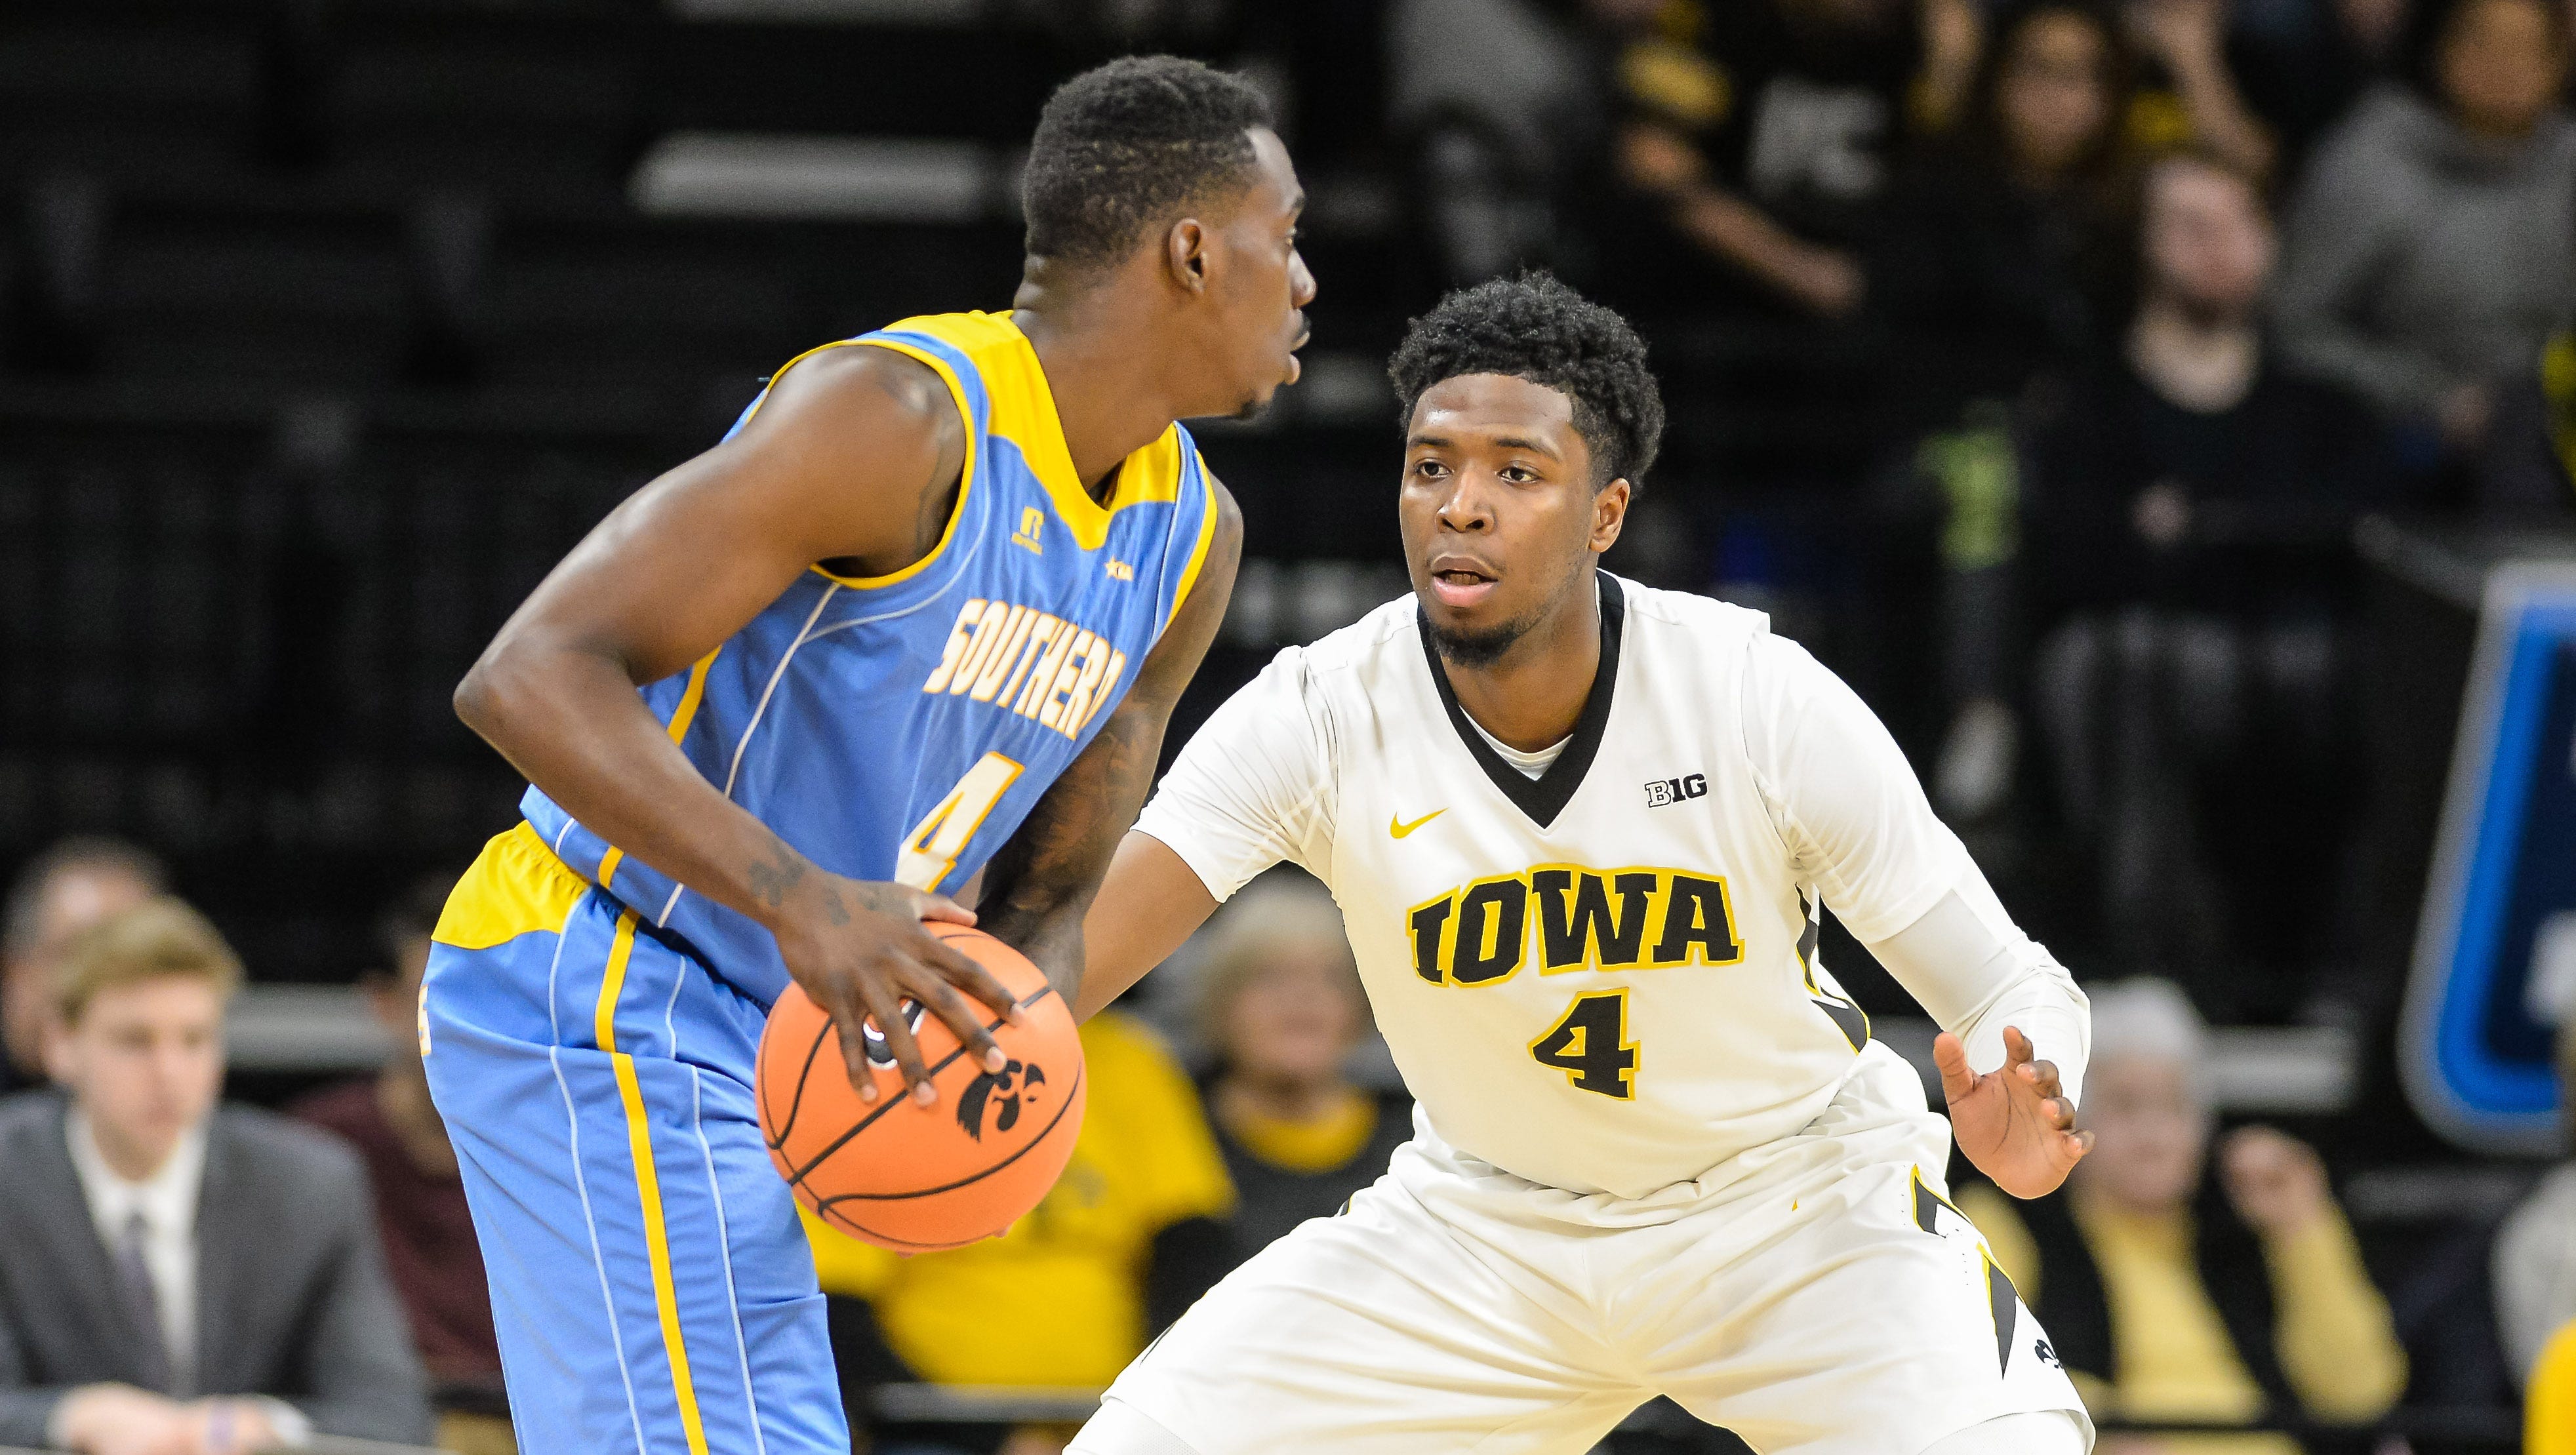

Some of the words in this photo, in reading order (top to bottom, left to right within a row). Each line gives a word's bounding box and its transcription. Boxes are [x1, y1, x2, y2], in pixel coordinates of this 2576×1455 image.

[894, 751, 1026, 894] 4
[1406, 862, 1745, 987] IOWA
[1527, 987, 1640, 1101] 4
